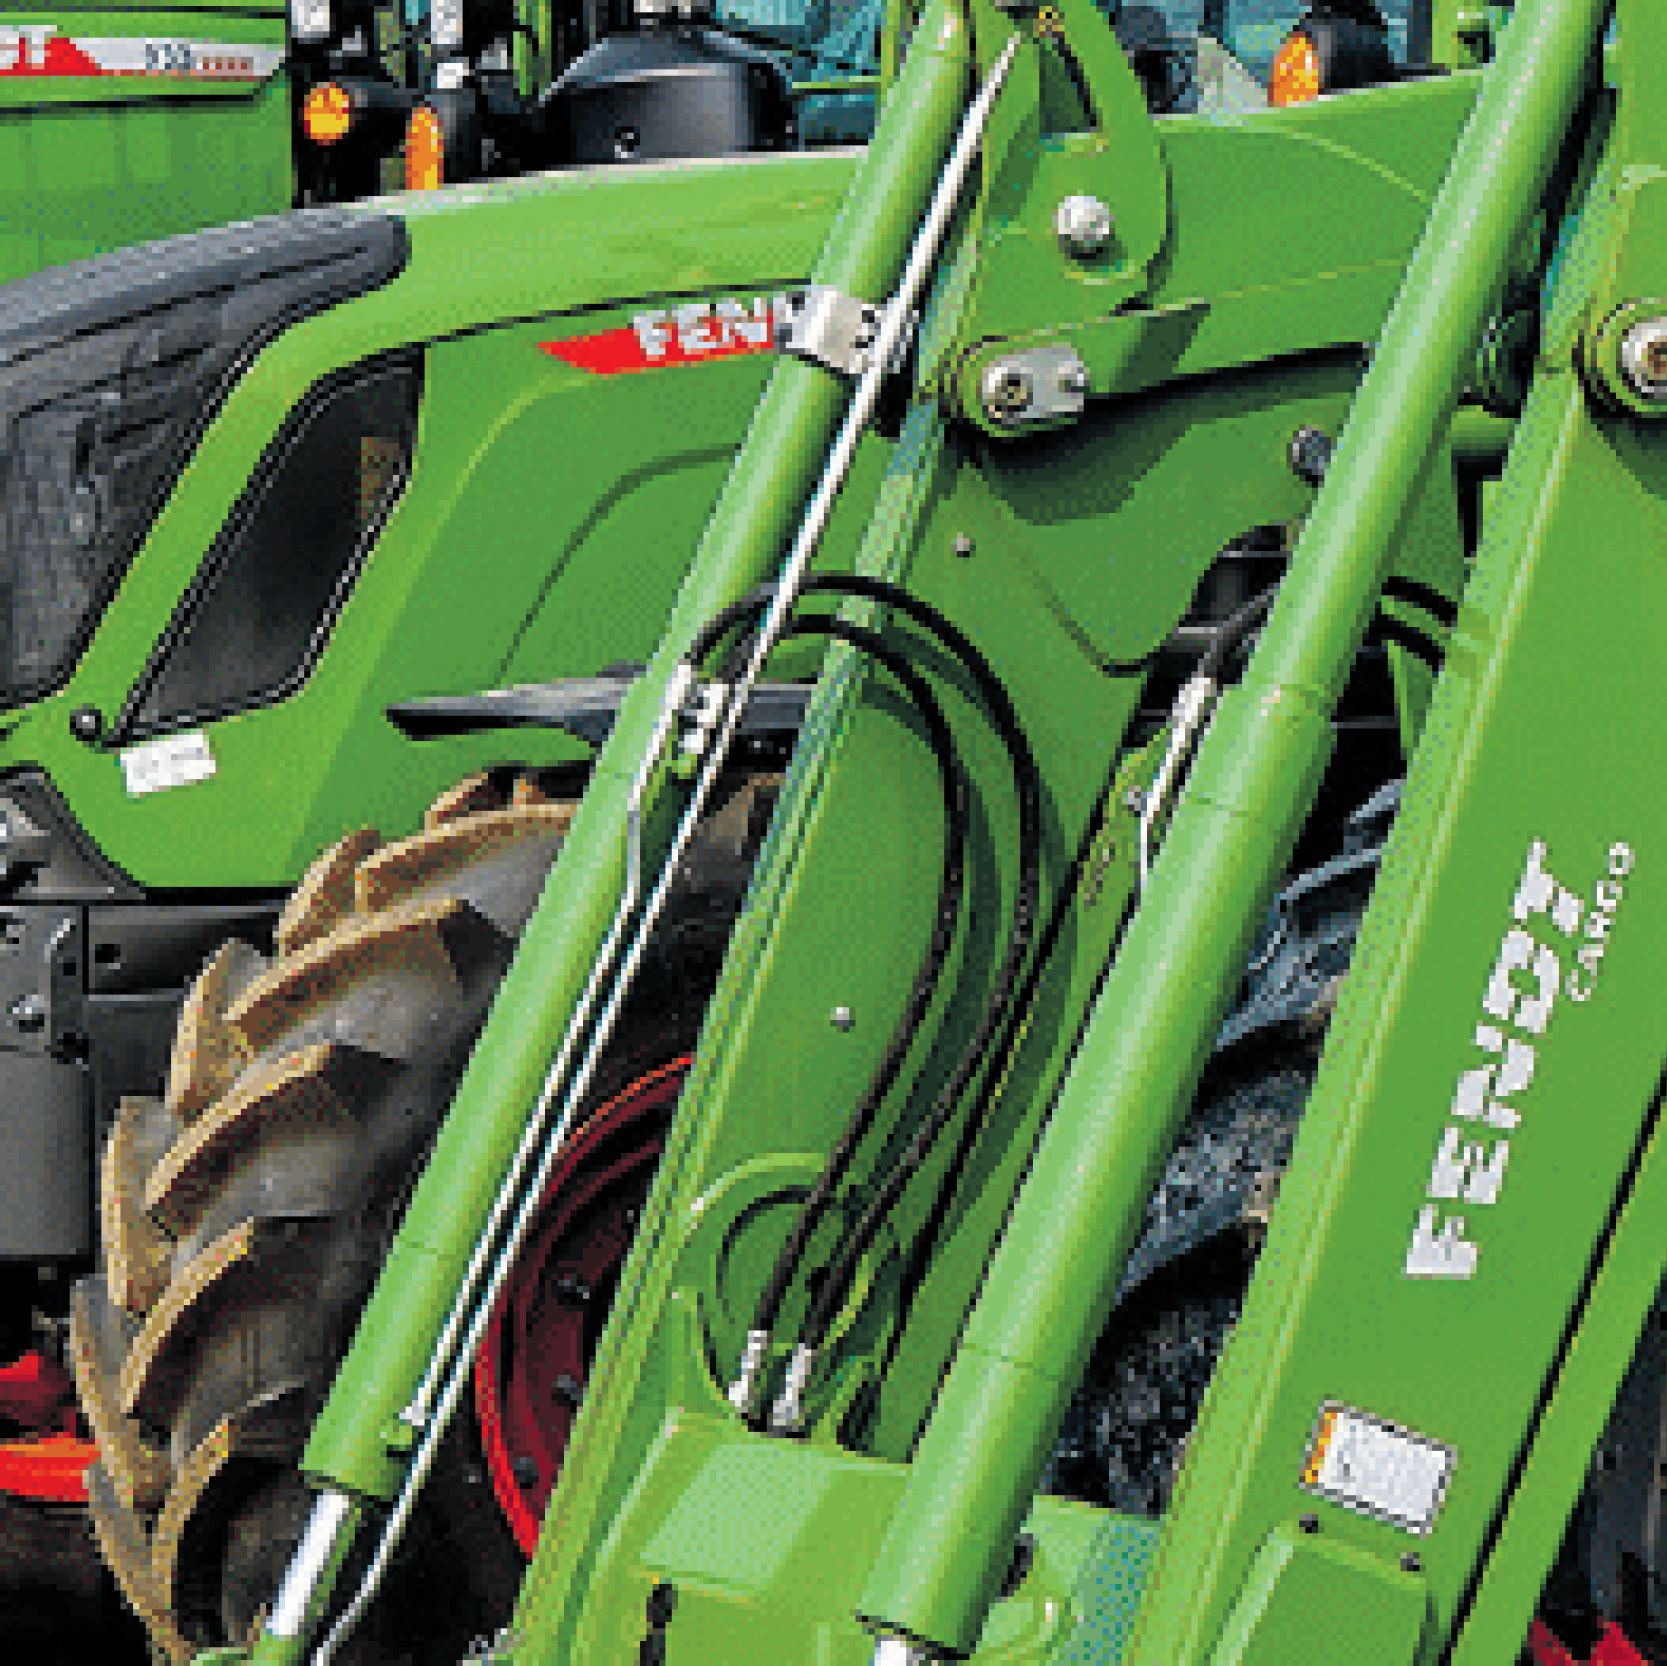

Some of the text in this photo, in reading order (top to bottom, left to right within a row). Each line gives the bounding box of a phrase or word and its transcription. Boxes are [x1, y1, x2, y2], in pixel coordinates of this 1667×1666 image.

[633, 295, 784, 357] FEN
[1565, 841, 1636, 1002] CARGO
[1402, 835, 1584, 1279] FENDT
